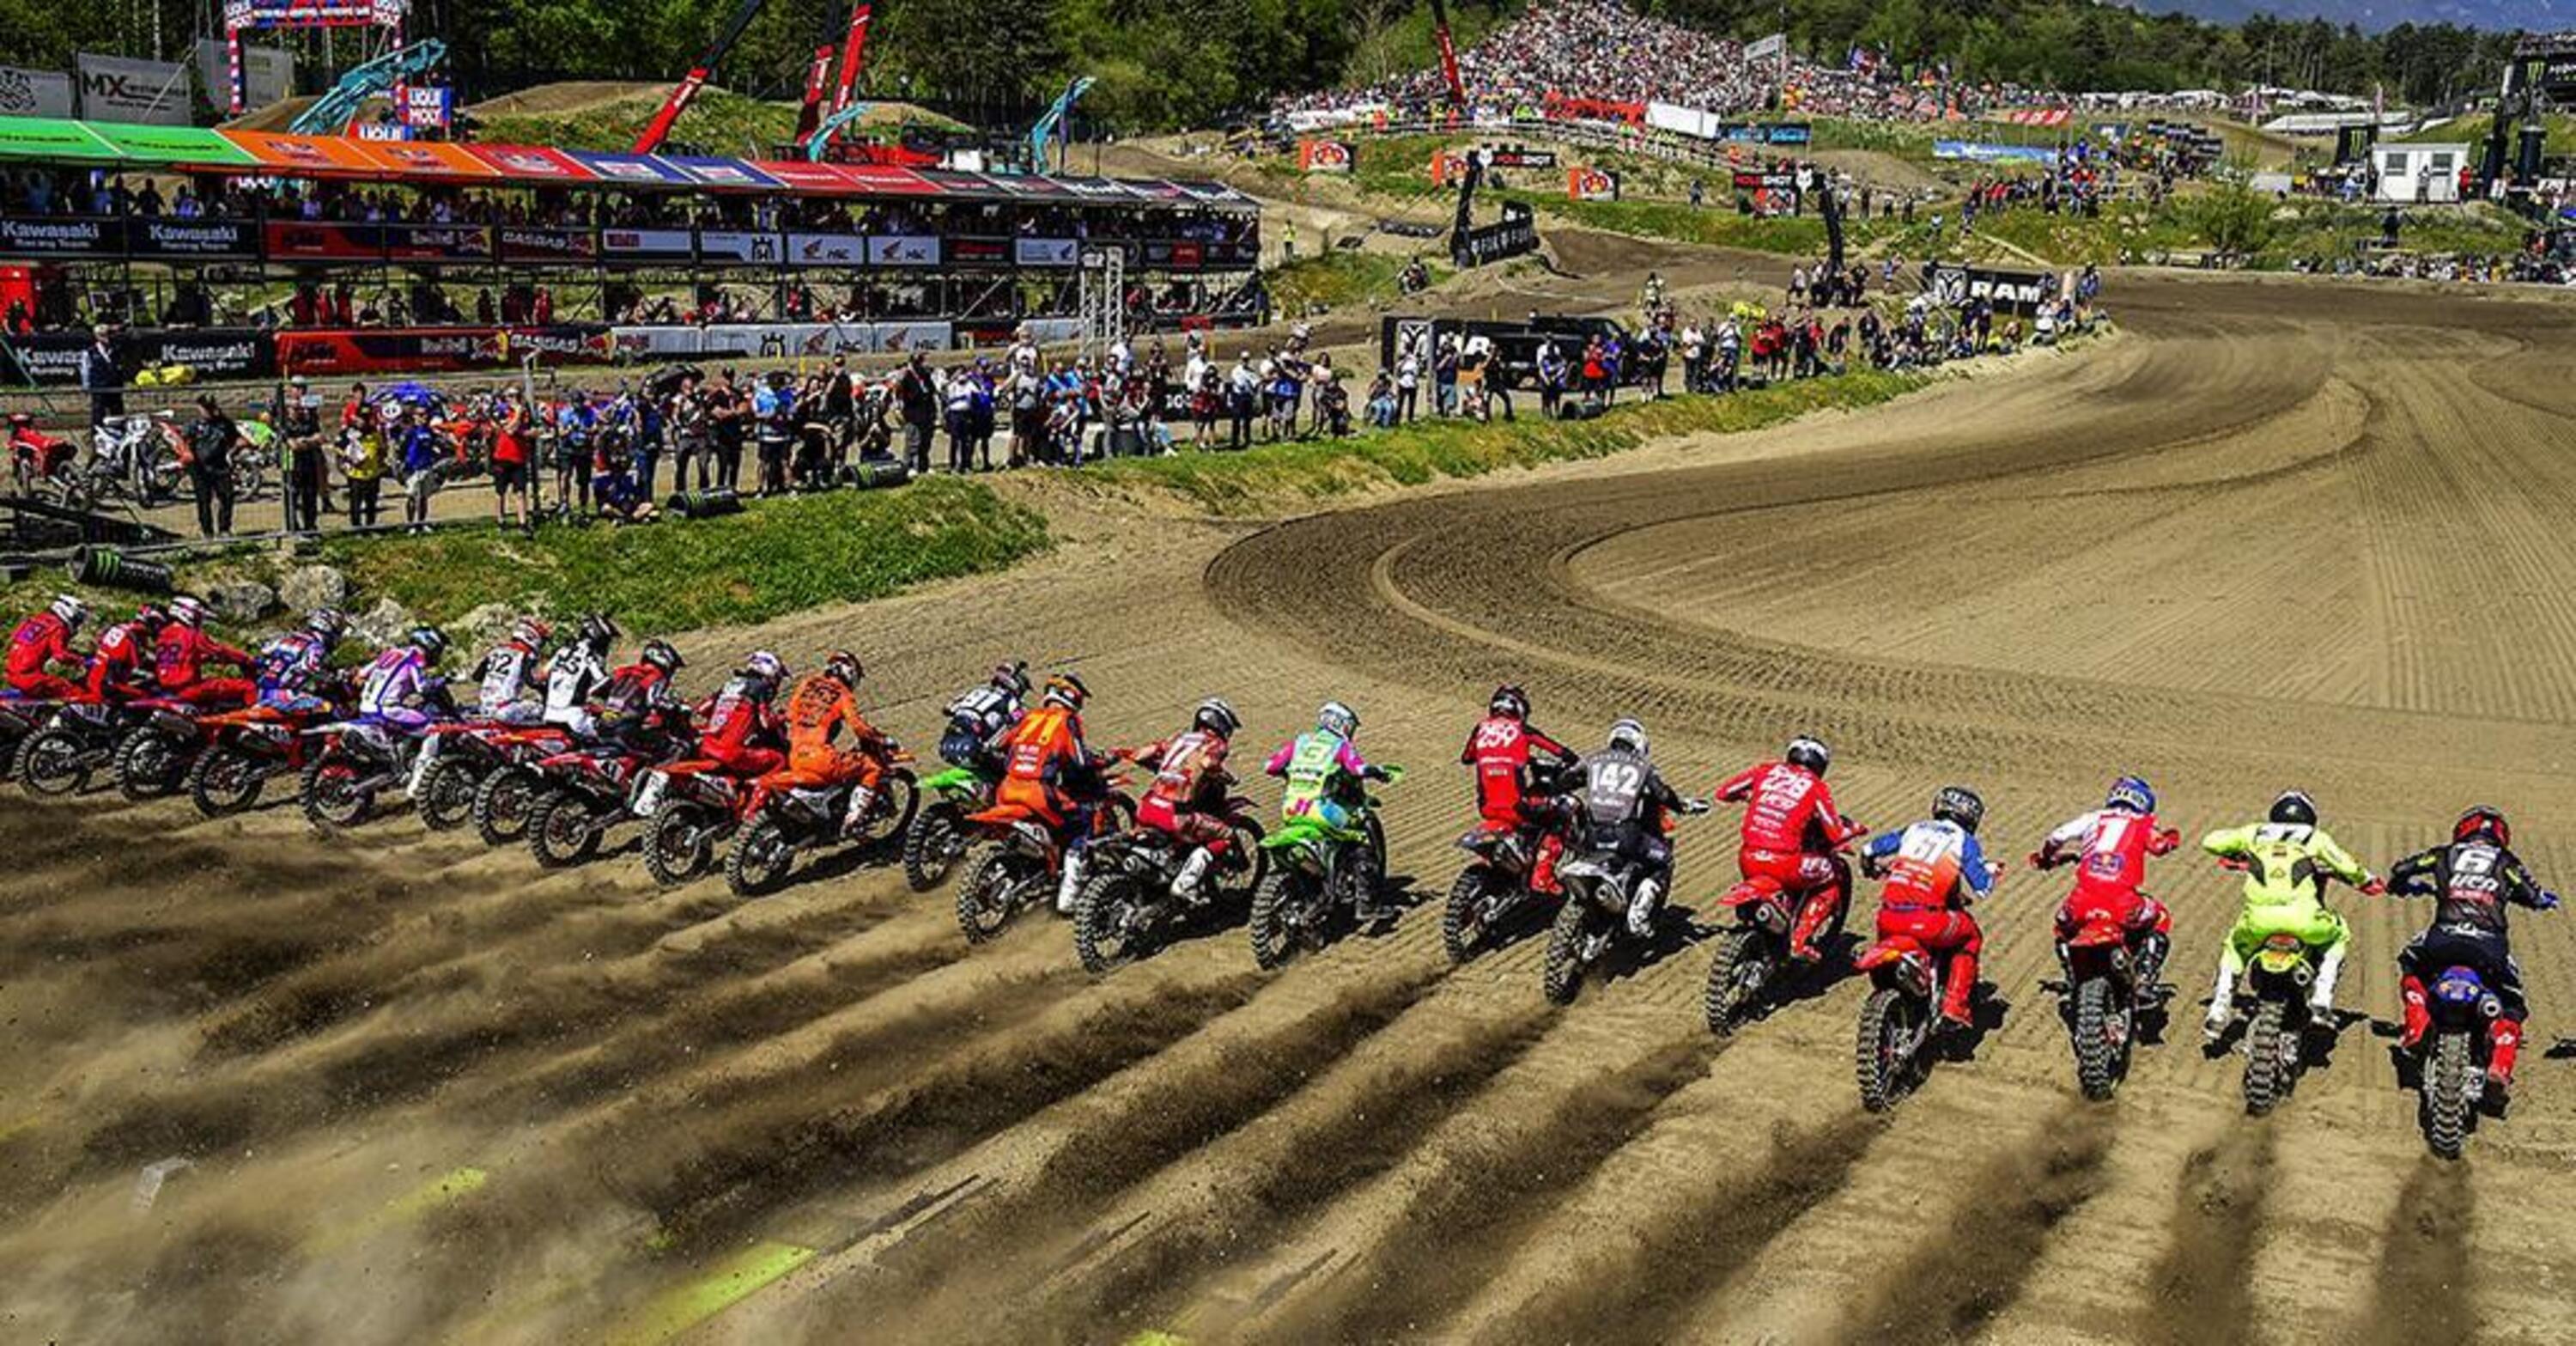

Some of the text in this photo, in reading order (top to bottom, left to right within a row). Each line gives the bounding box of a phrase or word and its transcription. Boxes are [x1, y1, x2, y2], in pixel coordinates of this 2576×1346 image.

[82, 72, 126, 97] MX
[2, 221, 100, 240] Kawasaki
[149, 224, 238, 242] Kawasaki
[1971, 280, 2042, 303] RAM
[15, 347, 87, 365] Kawas
[161, 343, 254, 362] Kawasaki
[1476, 720, 1522, 750] 259
[1589, 760, 1641, 795] 142
[2093, 816, 2131, 854] 1
[2454, 849, 2498, 875] 6
